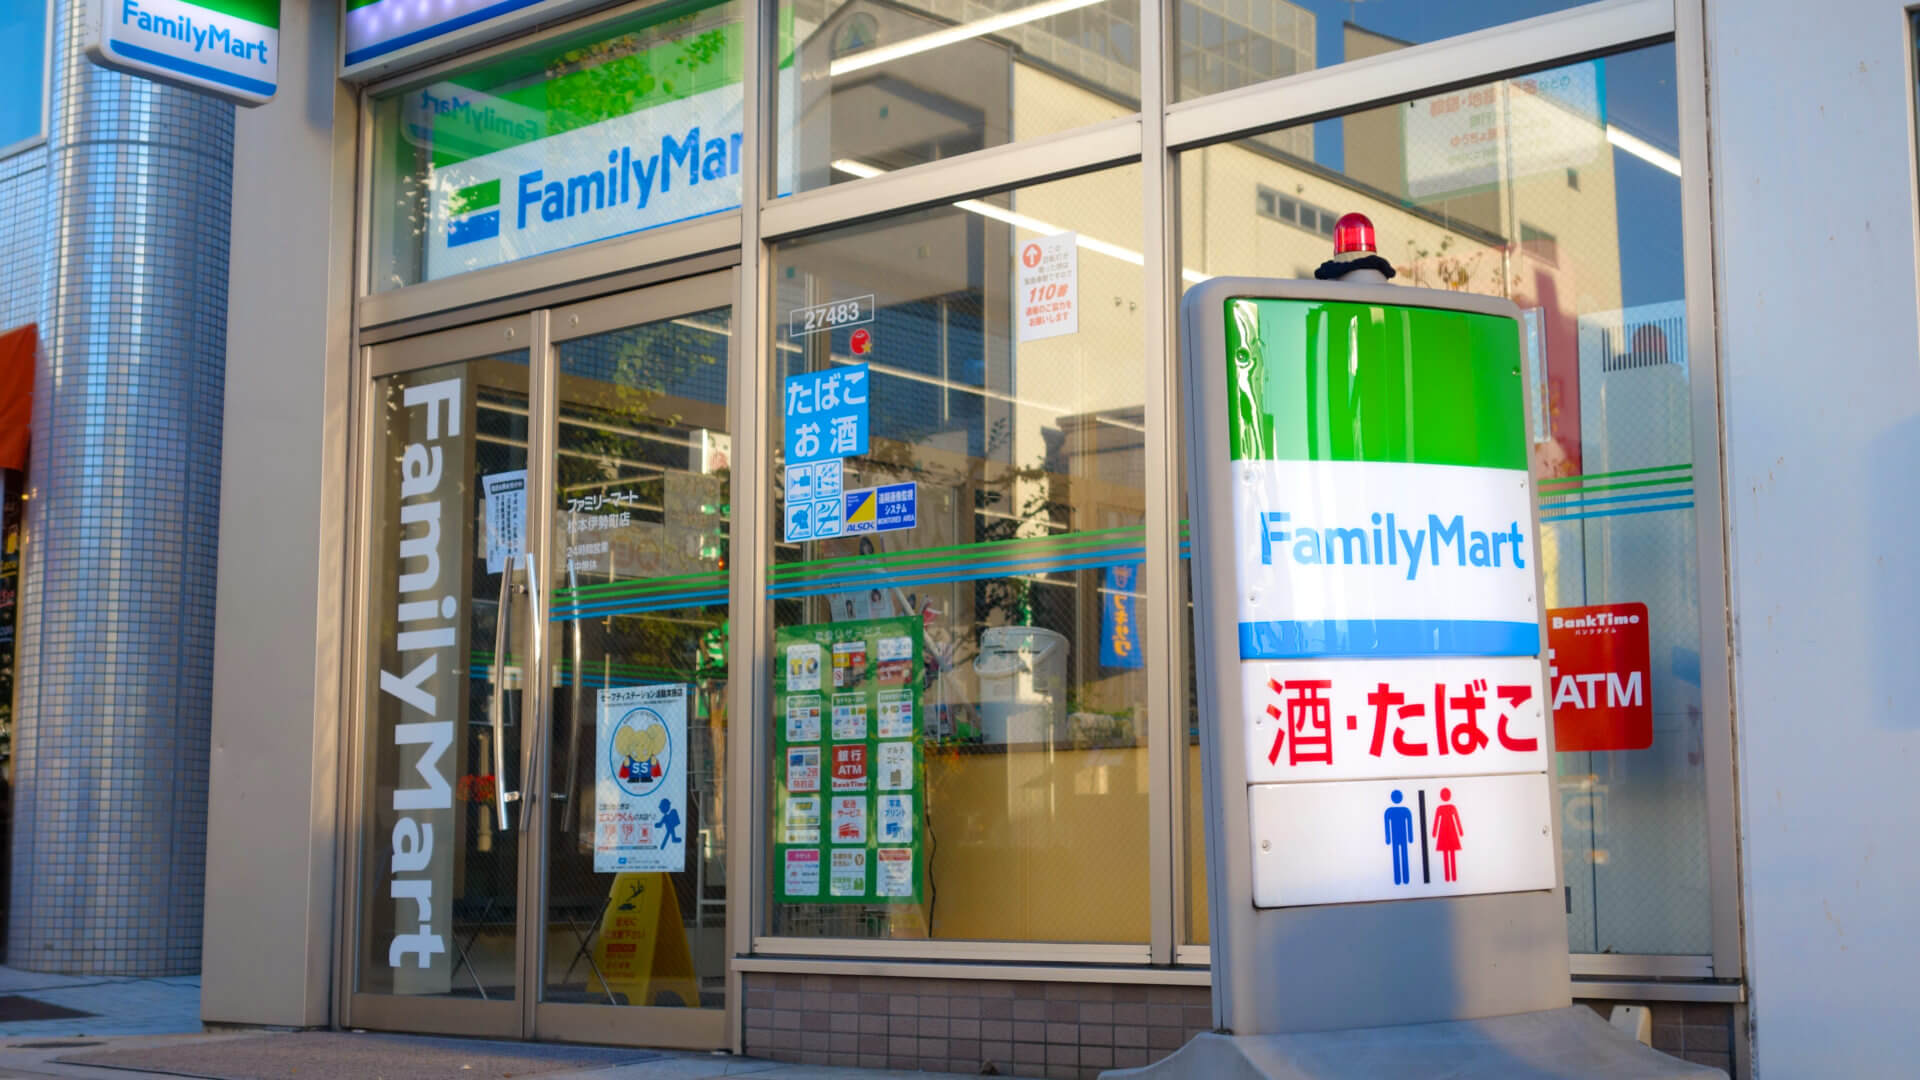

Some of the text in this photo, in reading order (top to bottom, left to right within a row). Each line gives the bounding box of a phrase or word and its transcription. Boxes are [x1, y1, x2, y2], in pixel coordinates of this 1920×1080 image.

[122, 0, 268, 65] FamilyMart
[517, 128, 743, 231] FamilyMar
[1029, 283, 1070, 304] 110番
[803, 301, 861, 331] 27483
[787, 369, 868, 417] たばこ
[793, 415, 859, 459] お酒
[567, 490, 639, 514] ファミリーマート
[884, 503, 908, 515] システム
[1259, 511, 1525, 581] FamilyMart
[1552, 612, 1640, 630] BankTime
[380, 378, 462, 969] FamilyMart
[1552, 671, 1643, 711] ATM
[1267, 678, 1539, 767] 酒・たばこ
[632, 763, 649, 774] SS
[837, 749, 862, 762] 銀行
[837, 764, 863, 776] ATM
[837, 808, 862, 818] サービス
